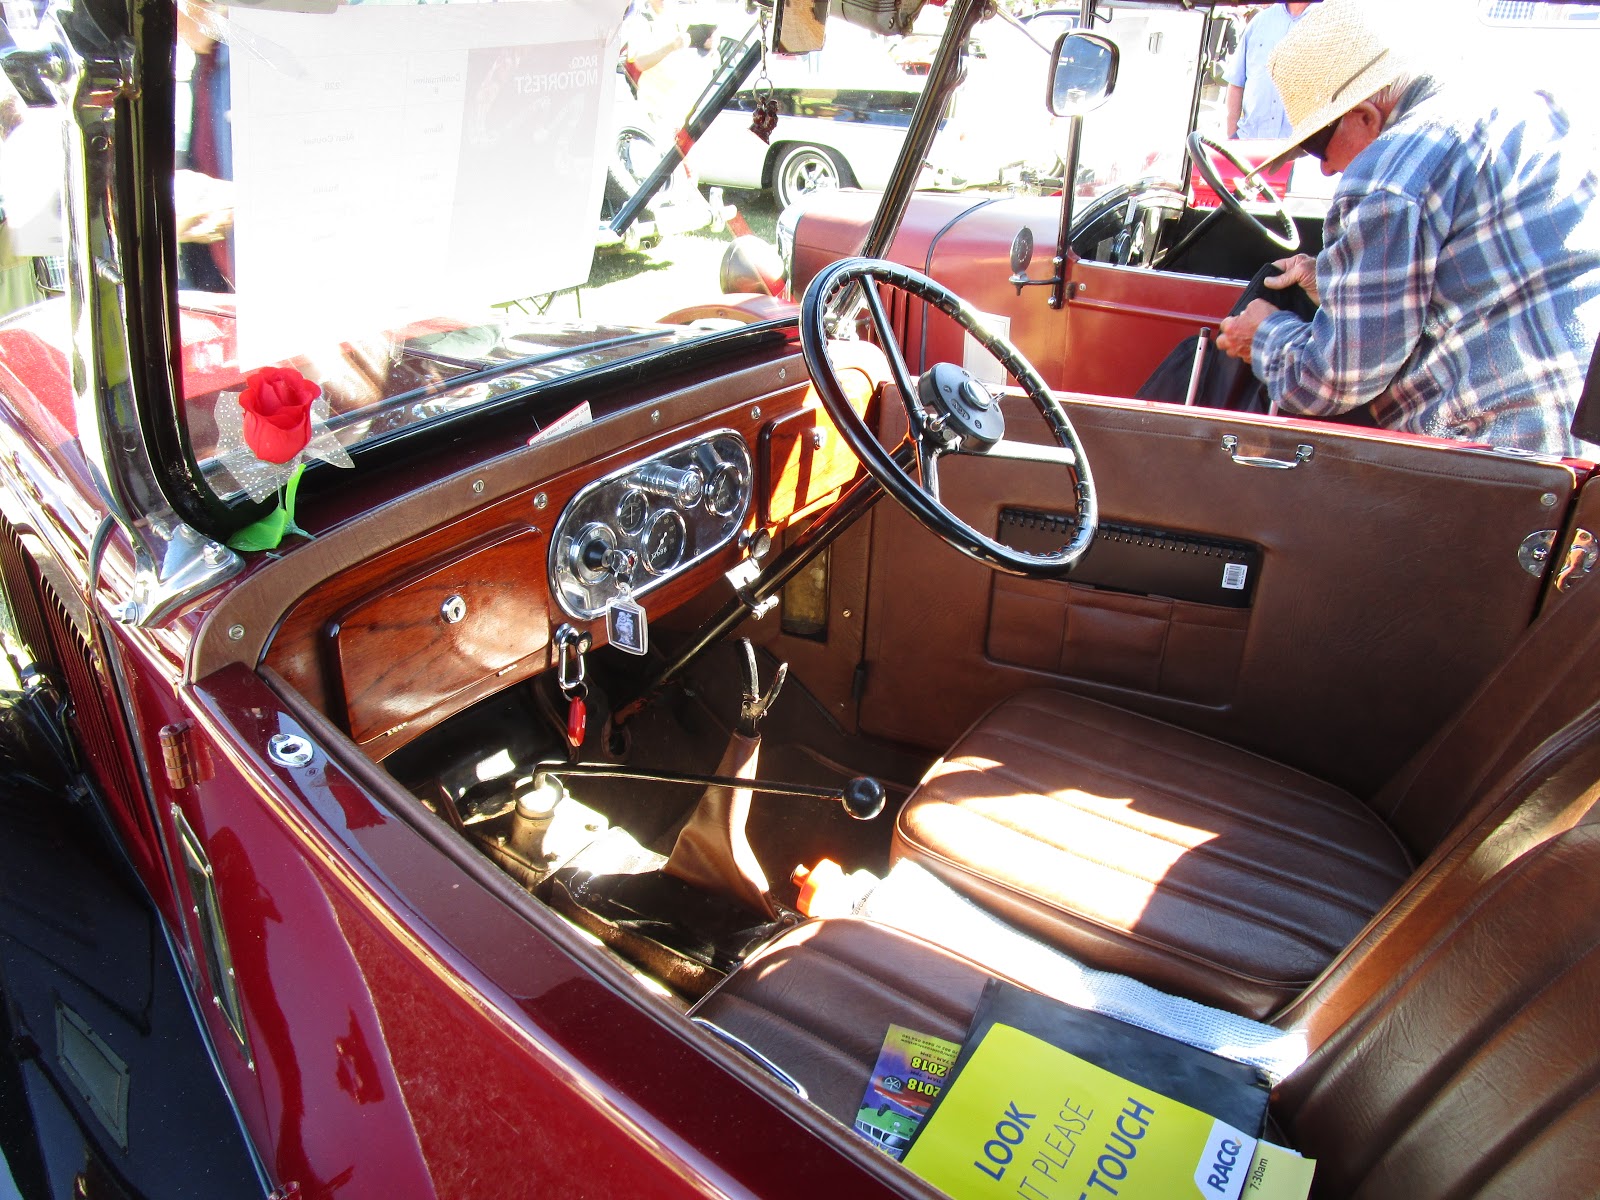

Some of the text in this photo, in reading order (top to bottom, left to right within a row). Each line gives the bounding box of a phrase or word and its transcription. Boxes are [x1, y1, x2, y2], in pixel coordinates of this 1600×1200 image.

[911, 1056, 948, 1077] 2018
[973, 1100, 1037, 1182] LOOK
[1031, 1097, 1094, 1183] PLEASE
[1086, 1096, 1155, 1197] TOUCH
[1207, 1138, 1242, 1194] RACQ
[1249, 1157, 1269, 1191] 7:30am
